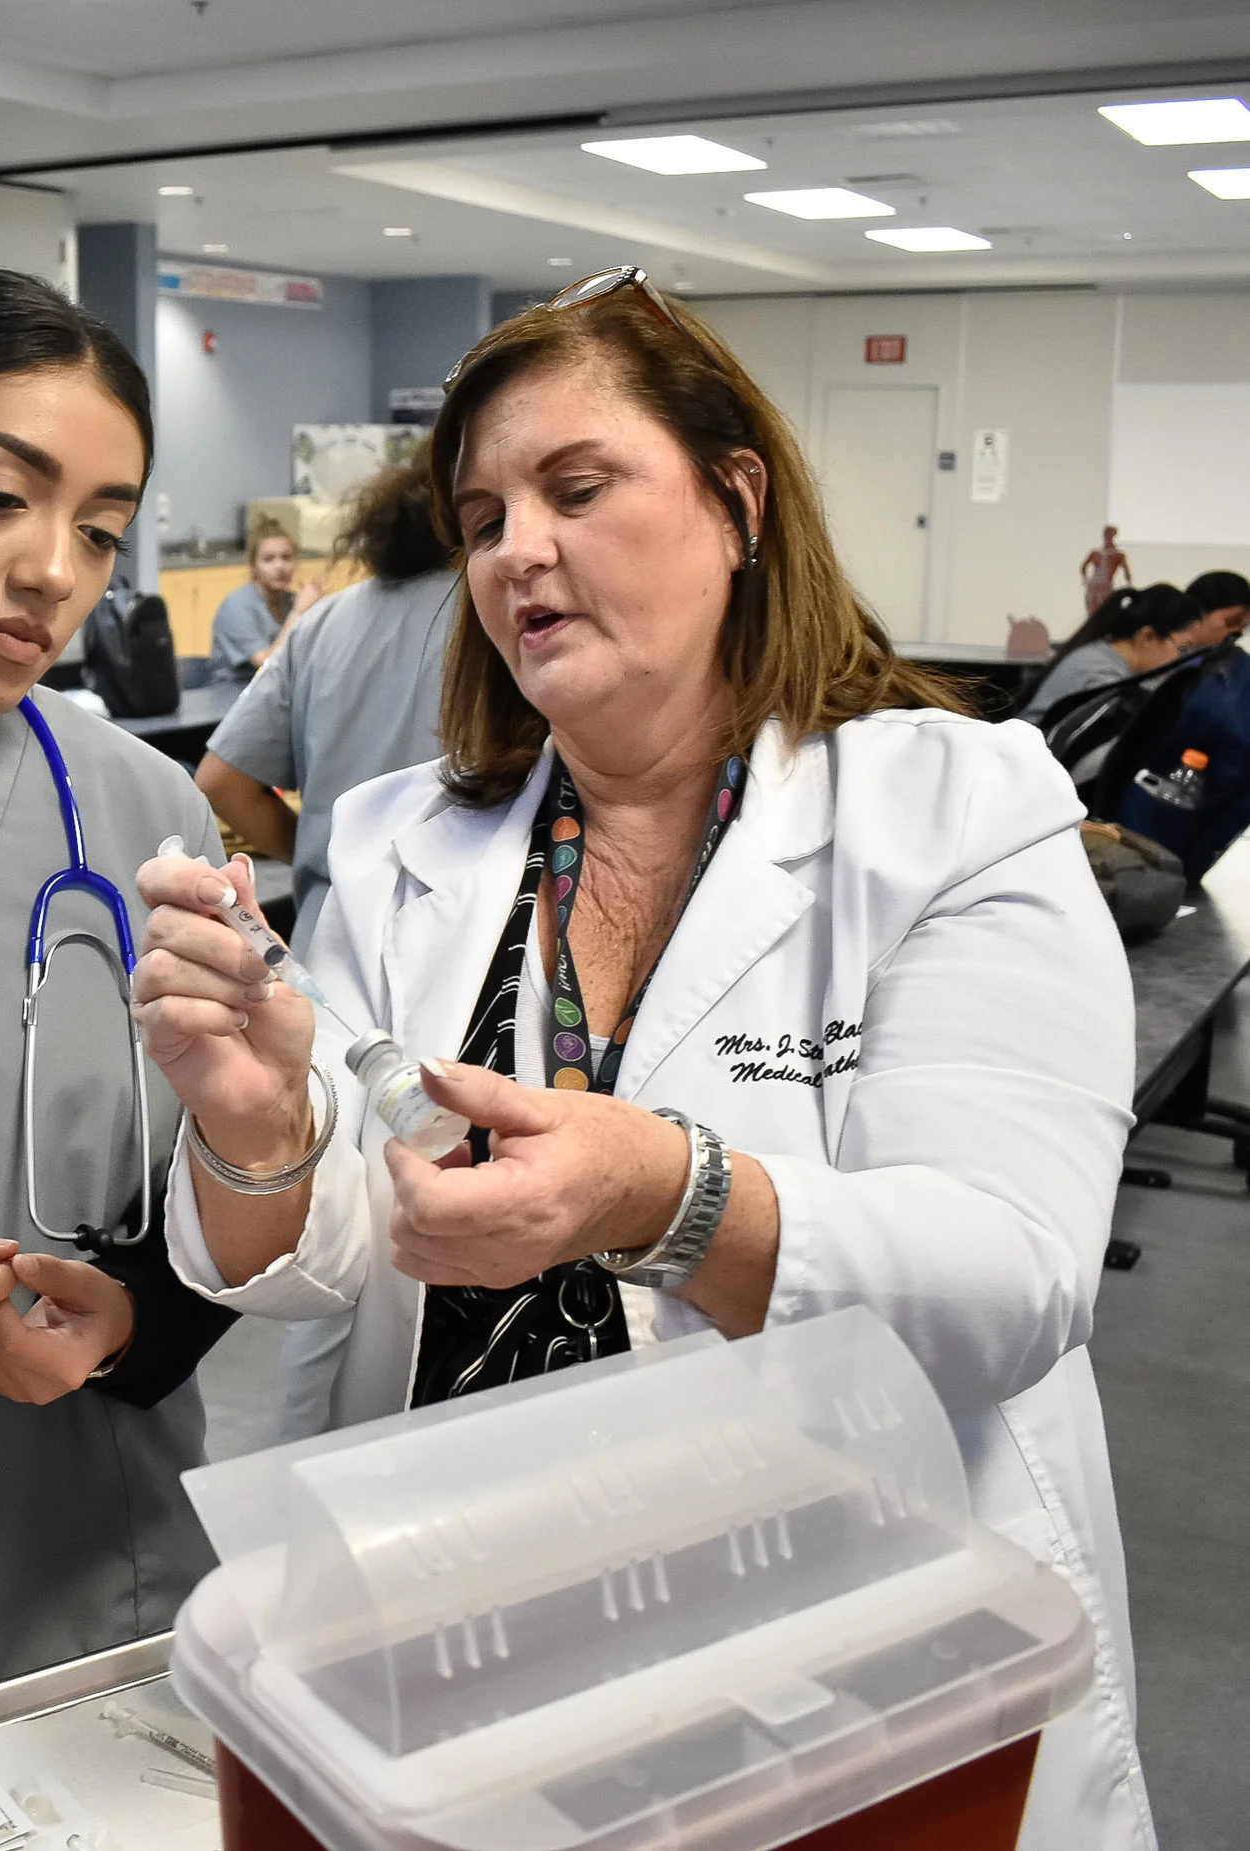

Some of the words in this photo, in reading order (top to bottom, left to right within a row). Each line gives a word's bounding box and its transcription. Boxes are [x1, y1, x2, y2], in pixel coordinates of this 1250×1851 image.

[715, 1033, 771, 1056] Mrs.
[776, 1034, 795, 1058] J.
[730, 1062, 823, 1088] Medical
